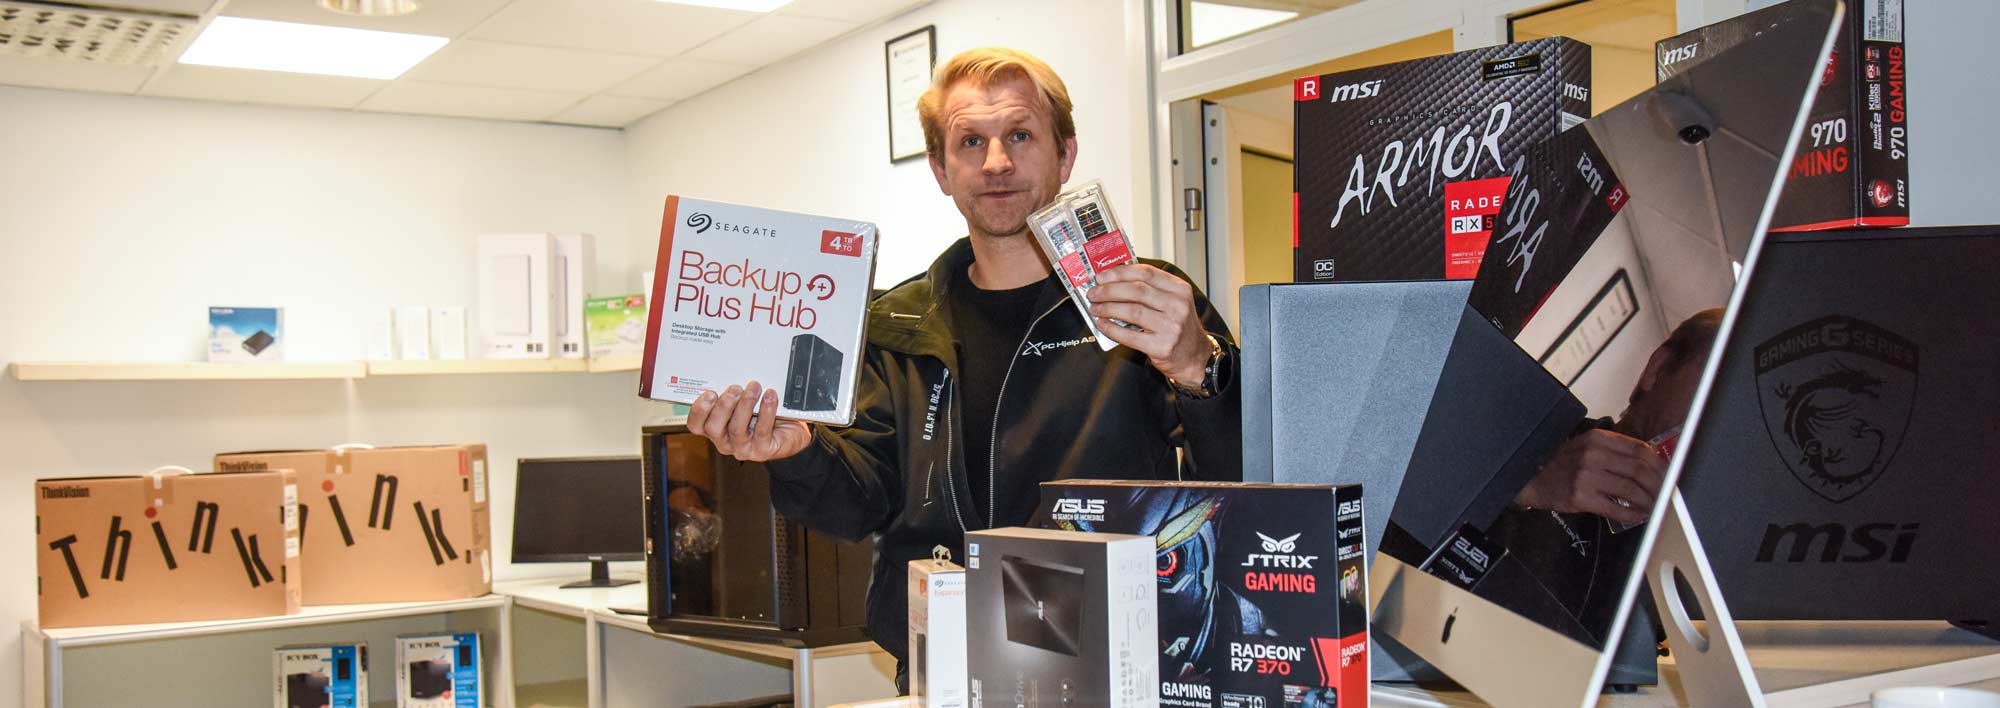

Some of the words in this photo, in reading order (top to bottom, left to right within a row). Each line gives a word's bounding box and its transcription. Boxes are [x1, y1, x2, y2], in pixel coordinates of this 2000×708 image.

[1664, 42, 1697, 65] msi
[1494, 62, 1512, 71] AMD
[1303, 80, 1317, 97] R
[1331, 79, 1382, 103] msi
[1563, 82, 1588, 102] msi
[1888, 47, 1905, 123] GAMING
[1369, 112, 1433, 126] GRAPHICS
[1443, 106, 1476, 116] CARD
[1811, 118, 1847, 147] 970
[1890, 127, 1905, 160] 970
[1330, 101, 1512, 229] ARMOR
[1897, 179, 1905, 207] msi
[1451, 195, 1501, 211] RADE
[715, 222, 777, 238] SEAGATE
[1454, 217, 1479, 231] RX
[829, 236, 842, 251] 4
[843, 236, 853, 244] TB
[843, 244, 853, 252] TO
[1316, 261, 1333, 271] OC
[679, 250, 802, 301] Backup
[674, 283, 741, 320] Plus
[749, 292, 817, 330] Hub
[671, 328, 697, 337] Integrated
[672, 322, 693, 331] Desktop
[694, 325, 714, 334] Storage
[1041, 342, 1055, 350] PC
[1056, 340, 1080, 349] Hjelp
[1081, 335, 1096, 343] AS
[1759, 330, 1818, 368] GAMING
[1850, 330, 1914, 363] SERIES
[220, 461, 268, 471] ThinkVision
[42, 486, 90, 499] ThinkVision
[1052, 498, 1105, 514] ASUS
[1337, 499, 1361, 515] ASUS
[49, 501, 275, 599] Think
[1754, 522, 1920, 564] msi
[1241, 554, 1319, 569] STRIX
[1245, 571, 1316, 593] GAMING
[1230, 642, 1301, 661] RADEON
[1341, 641, 1366, 657] RADEON
[1231, 658, 1253, 672] R7
[1256, 660, 1291, 676] 370
[1341, 657, 1350, 669] R7
[1162, 681, 1212, 700] GAMING
[1182, 699, 1195, 707] Card
[1195, 700, 1212, 708] Brand
